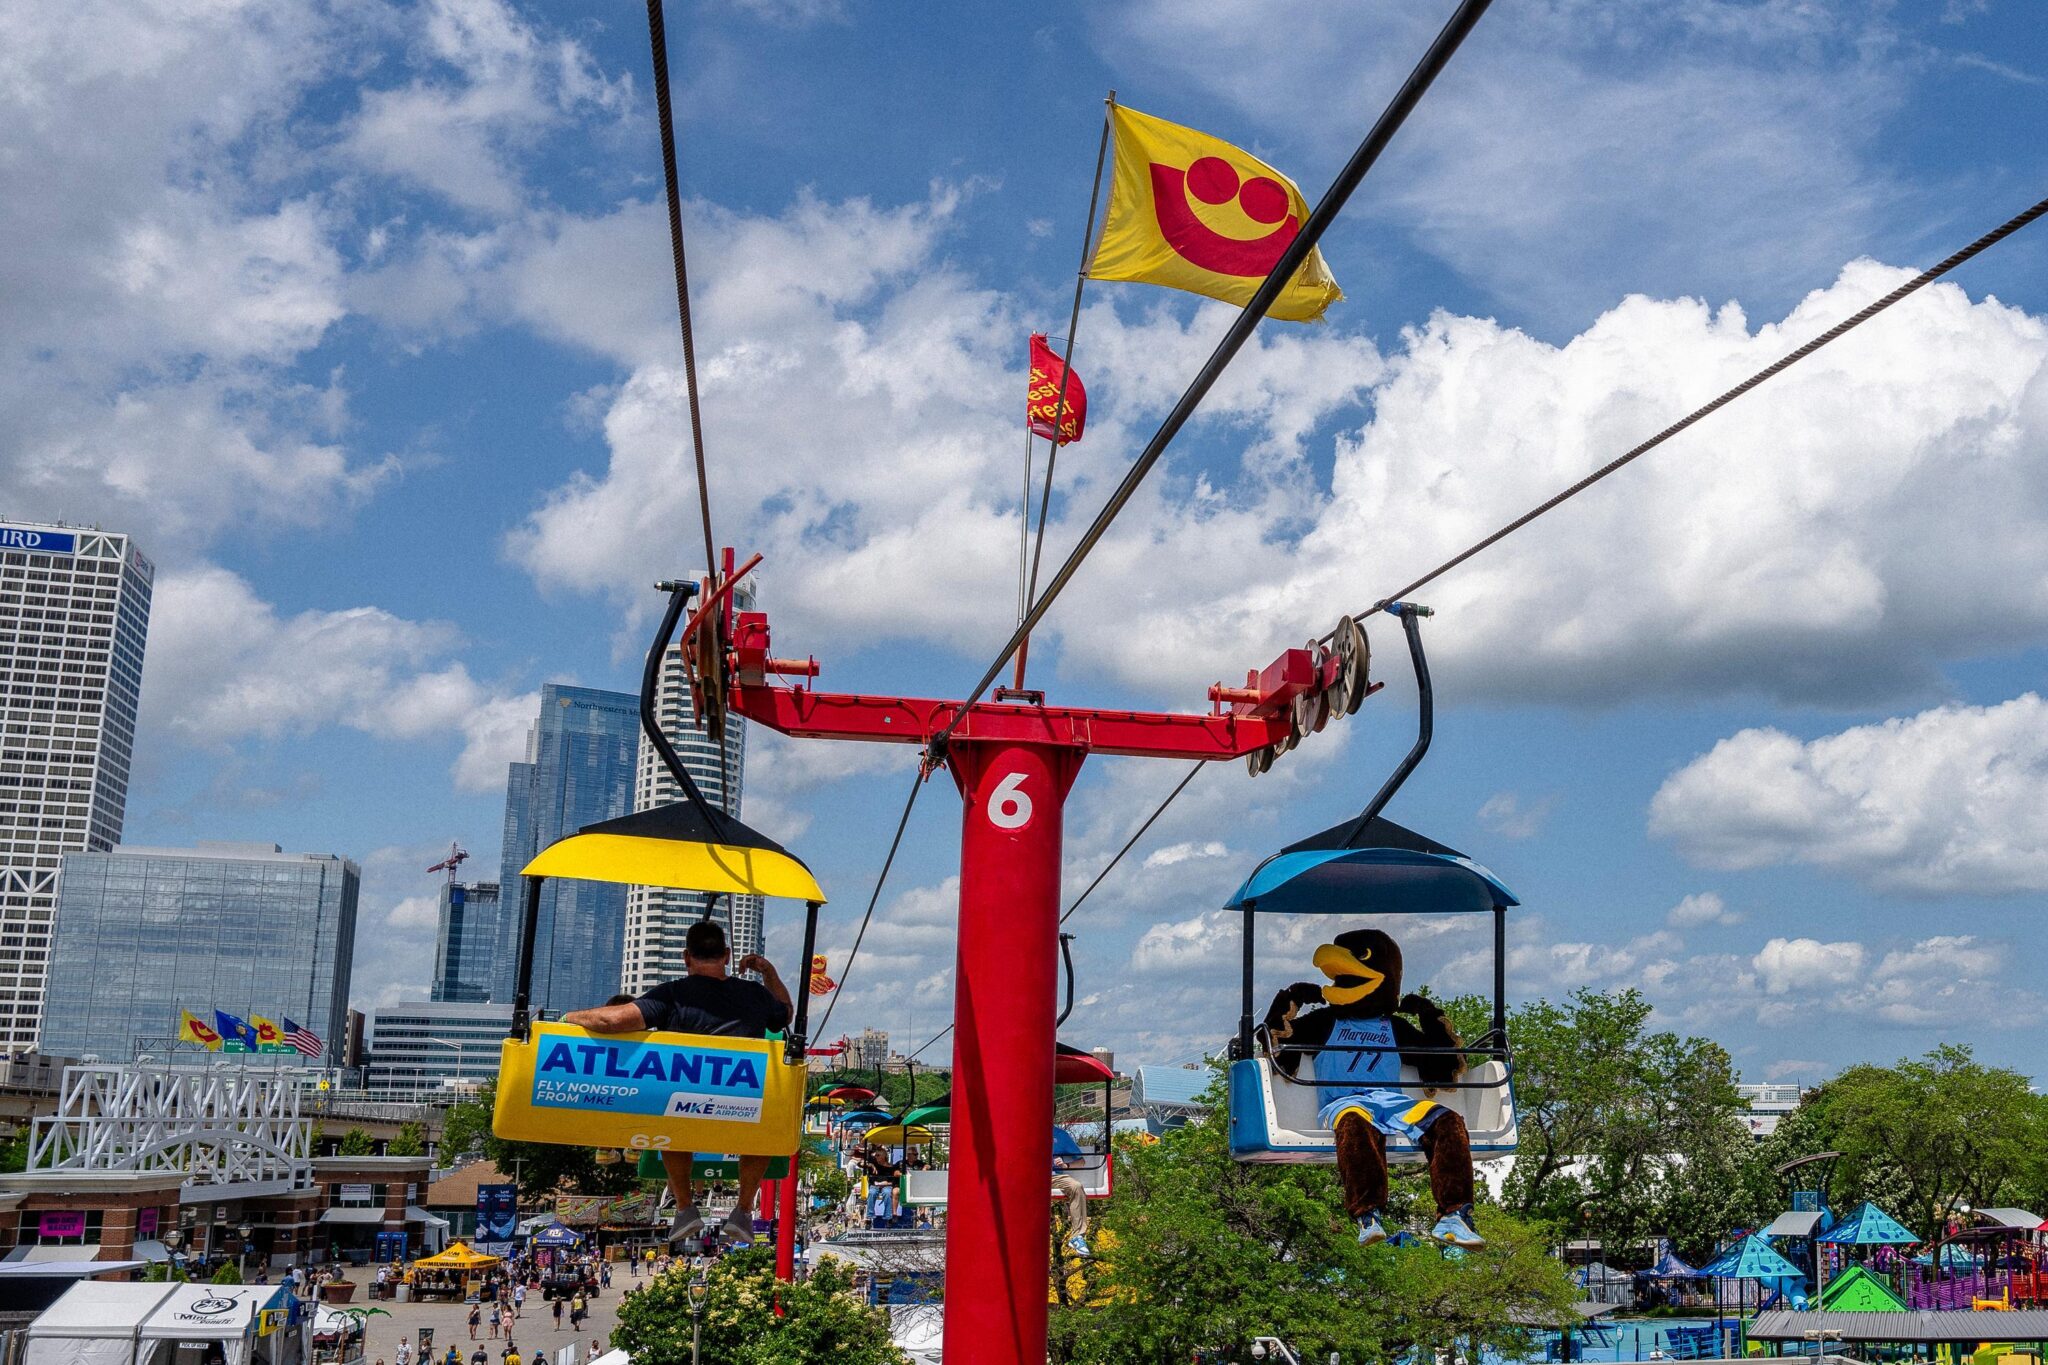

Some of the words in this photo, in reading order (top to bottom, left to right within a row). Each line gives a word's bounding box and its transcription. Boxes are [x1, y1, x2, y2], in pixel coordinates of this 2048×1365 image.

[574, 701, 627, 715] Northwestern
[987, 772, 1033, 829] 6
[1337, 1028, 1391, 1045] Marquette
[540, 1042, 760, 1089] ATLANTA
[537, 1080, 565, 1091] FLY
[567, 1082, 639, 1097] NONSTOP
[536, 1091, 580, 1104] FROM
[583, 1094, 616, 1106] MKE
[675, 1101, 715, 1115] MKE
[716, 1104, 759, 1113] MILWAUKEE
[714, 1109, 757, 1118] AIRPORT
[630, 1133, 672, 1149] 62
[704, 1168, 723, 1177] 61
